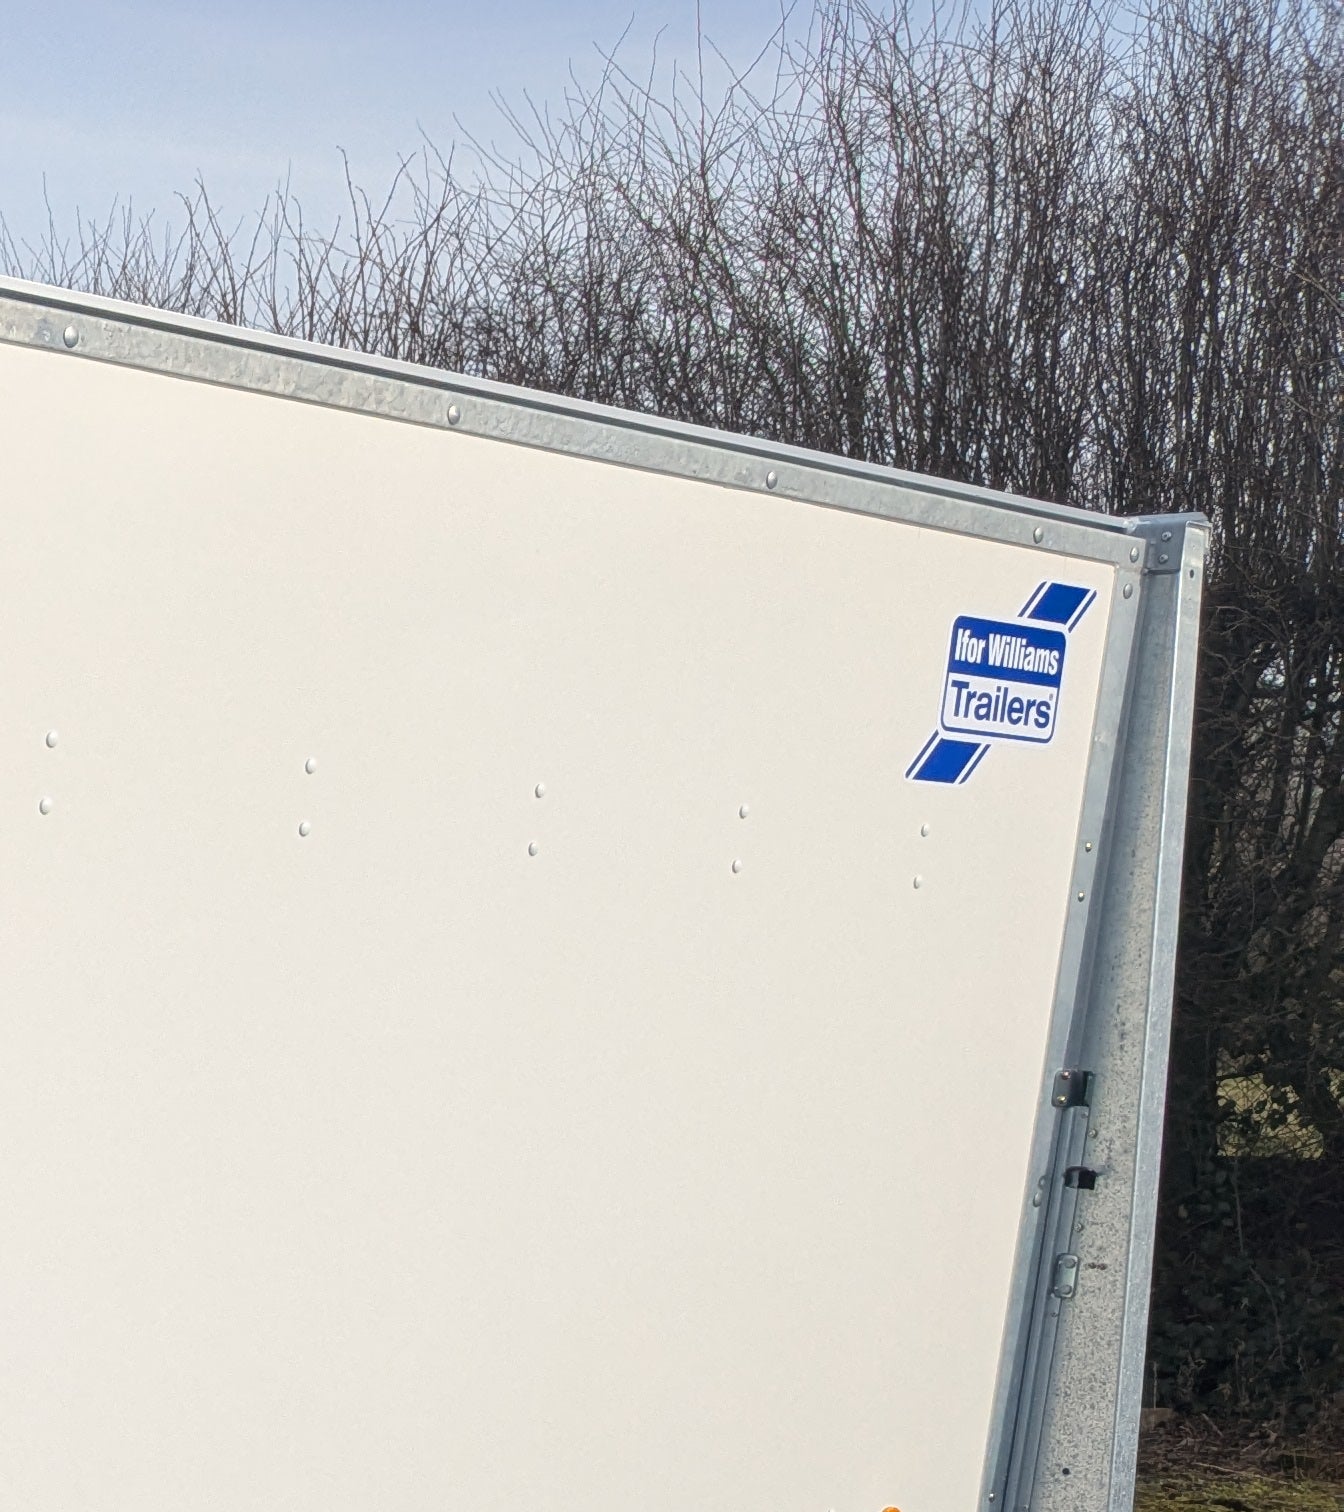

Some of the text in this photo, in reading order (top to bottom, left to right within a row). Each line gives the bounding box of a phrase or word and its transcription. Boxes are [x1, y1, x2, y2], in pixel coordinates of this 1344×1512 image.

[954, 628, 1060, 675] Ifor Williams
[951, 679, 1051, 729] Trailers
